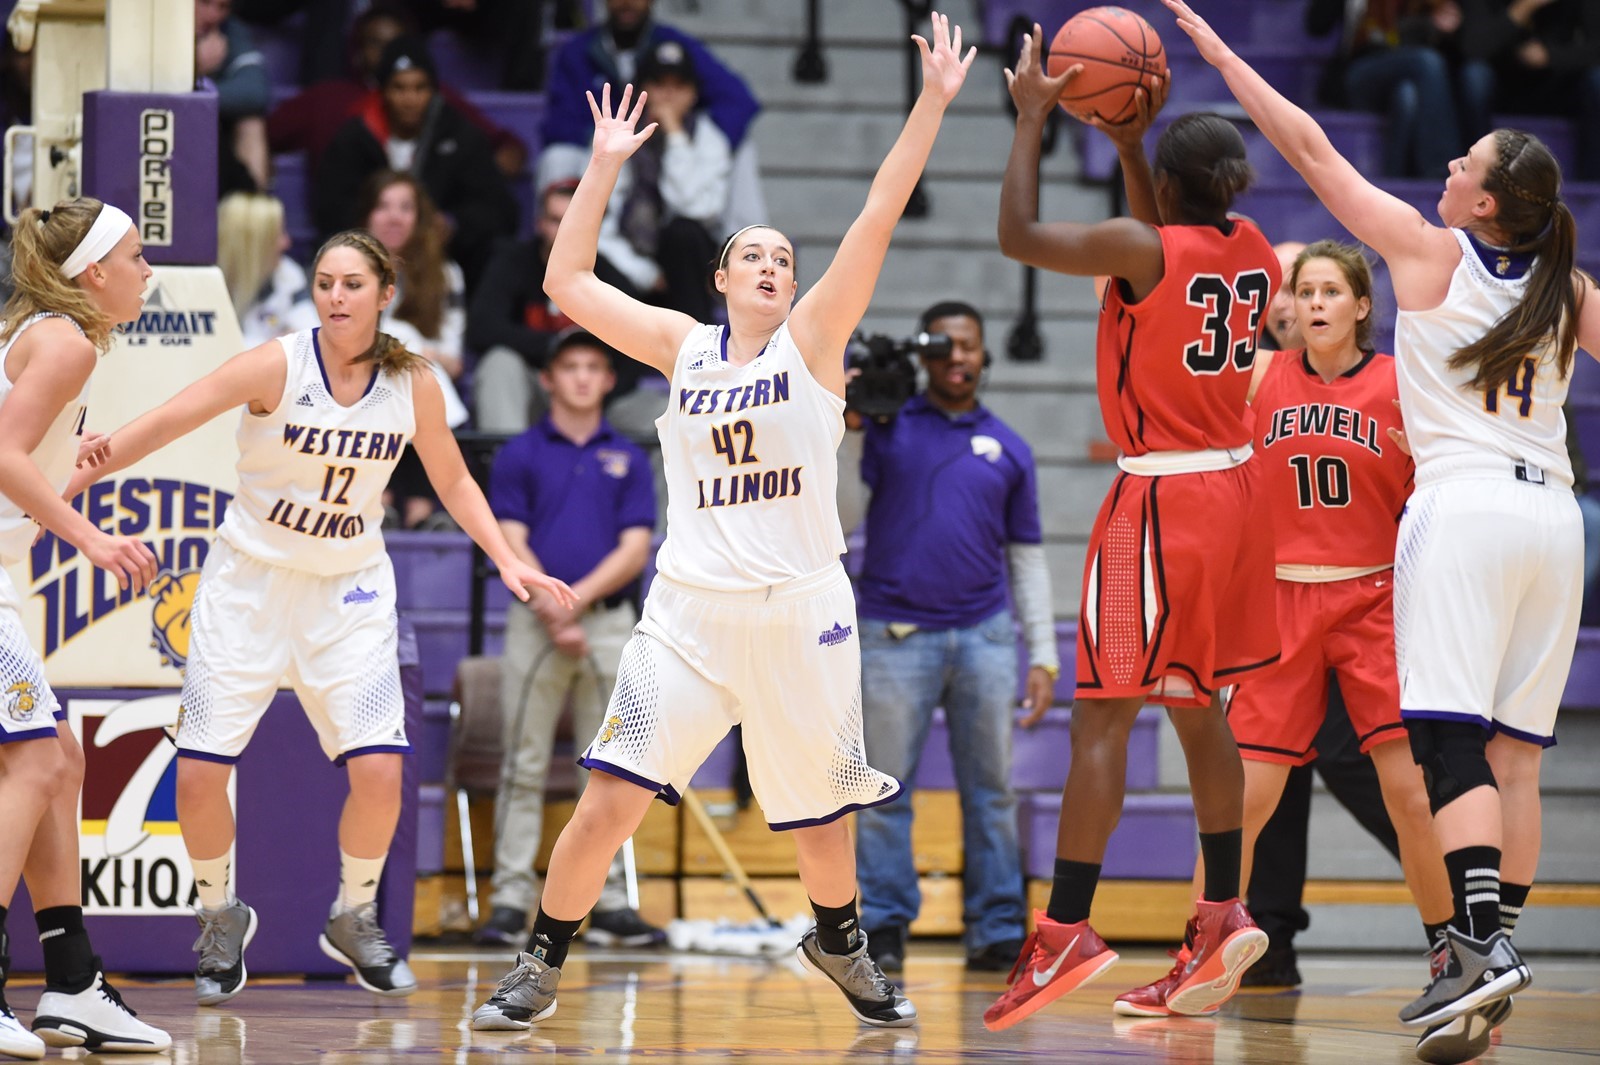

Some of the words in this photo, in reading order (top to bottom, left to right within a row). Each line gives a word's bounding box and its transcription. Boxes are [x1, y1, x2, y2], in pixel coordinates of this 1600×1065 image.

[143, 113, 168, 241] PORTER
[115, 311, 216, 334] MMIT
[1182, 268, 1271, 377] 33
[679, 371, 790, 417] WESTERN
[283, 423, 404, 461] WESTERN
[711, 419, 762, 466] 42
[1264, 403, 1382, 457] JEWELL
[318, 463, 358, 506] 12
[697, 466, 804, 510] ILINOIS
[1288, 454, 1351, 509] 10
[29, 478, 235, 586] WESTE
[818, 624, 853, 646] SUMMIT
